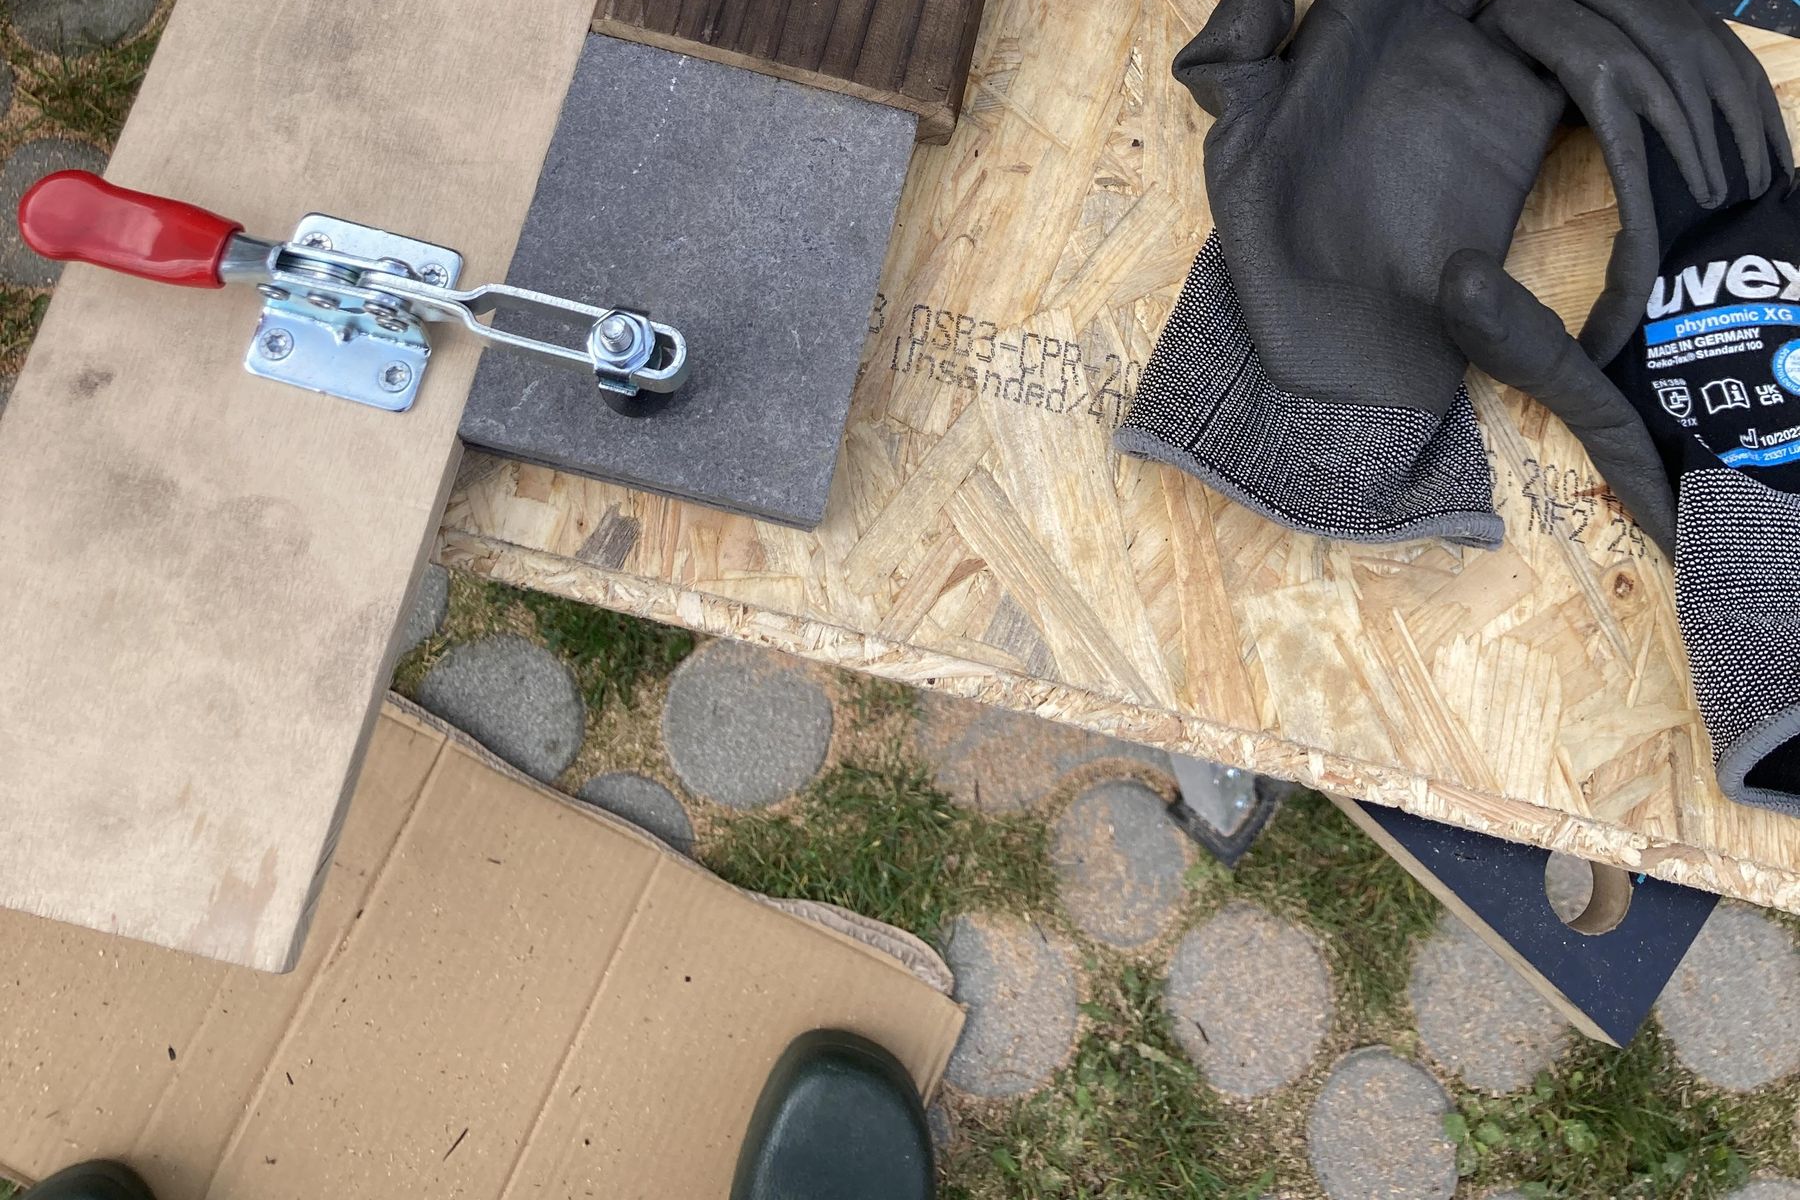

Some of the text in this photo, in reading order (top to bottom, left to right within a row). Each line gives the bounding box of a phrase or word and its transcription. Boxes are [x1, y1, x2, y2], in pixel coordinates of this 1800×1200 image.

[1646, 254, 1800, 320] uvex
[1675, 307, 1793, 338] phynomic XG
[1648, 327, 1760, 359] MADE IN GERMANY
[1695, 343, 1744, 360] Standard
[1746, 340, 1764, 351] 100
[1652, 379, 1667, 389] EN
[1755, 384, 1779, 395] UK
[1760, 393, 1784, 406] CA
